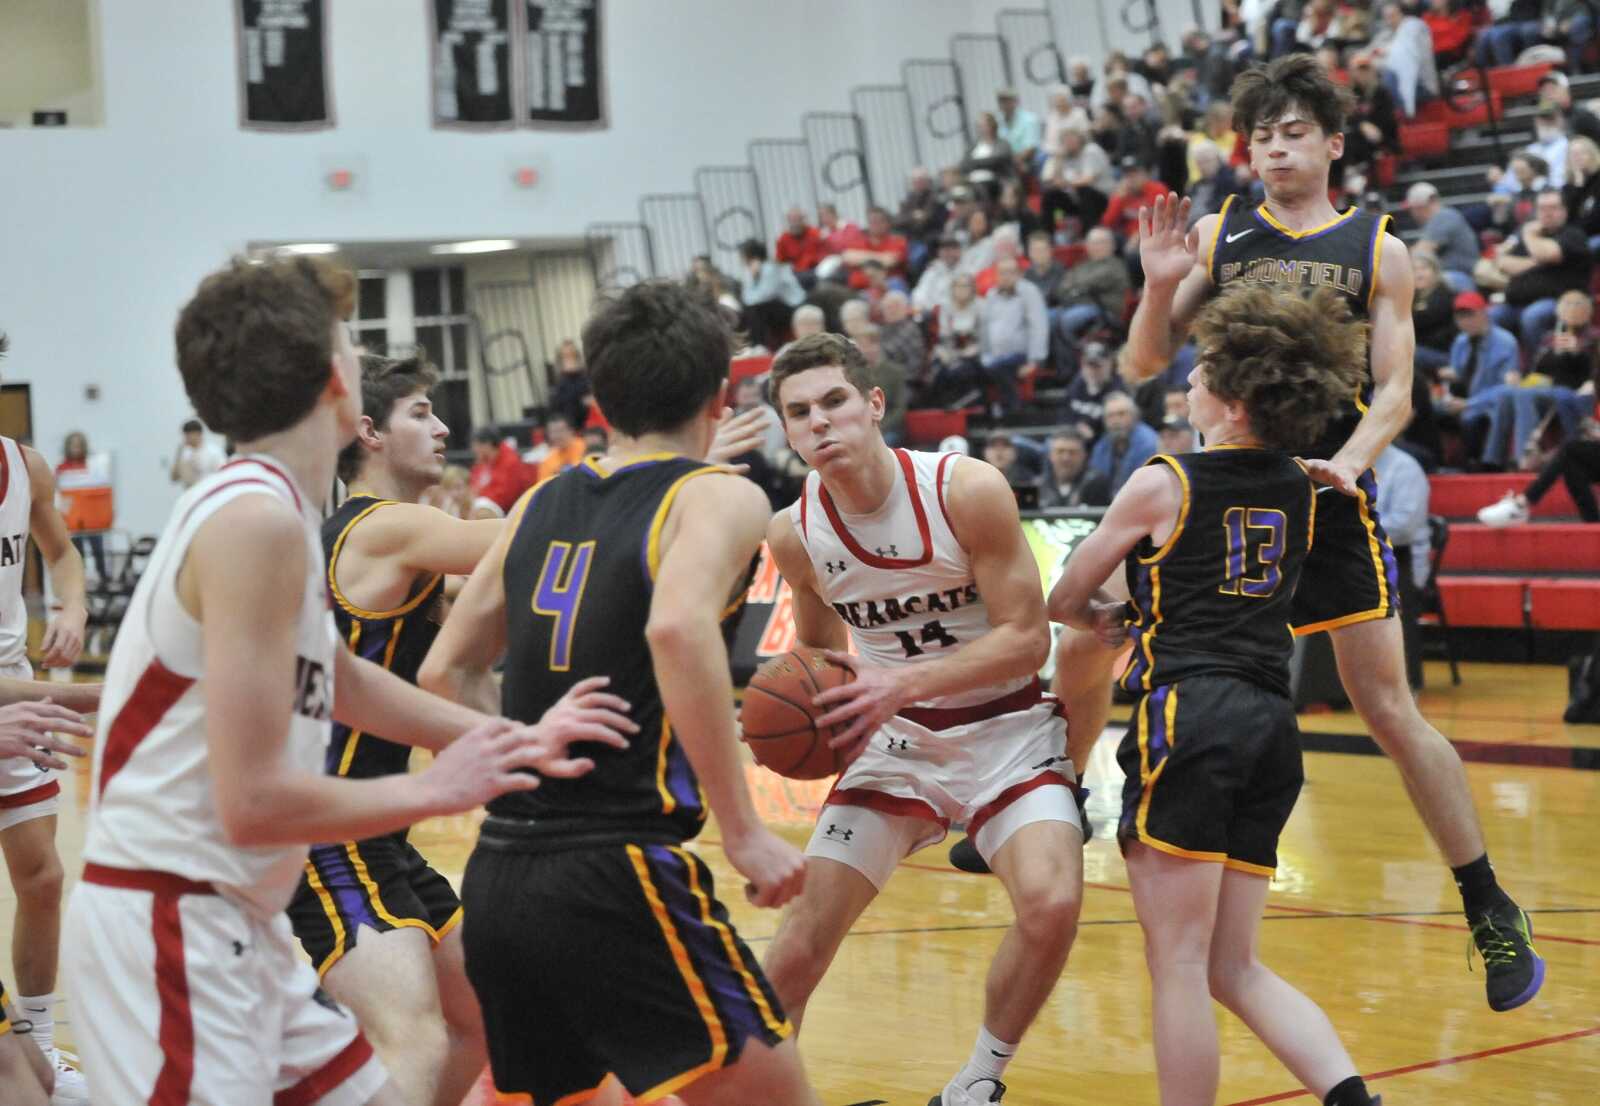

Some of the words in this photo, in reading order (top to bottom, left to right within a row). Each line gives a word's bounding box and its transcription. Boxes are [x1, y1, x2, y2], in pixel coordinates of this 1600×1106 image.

[1218, 507, 1287, 597] 13
[531, 540, 596, 672] 4
[895, 620, 958, 657] 14
